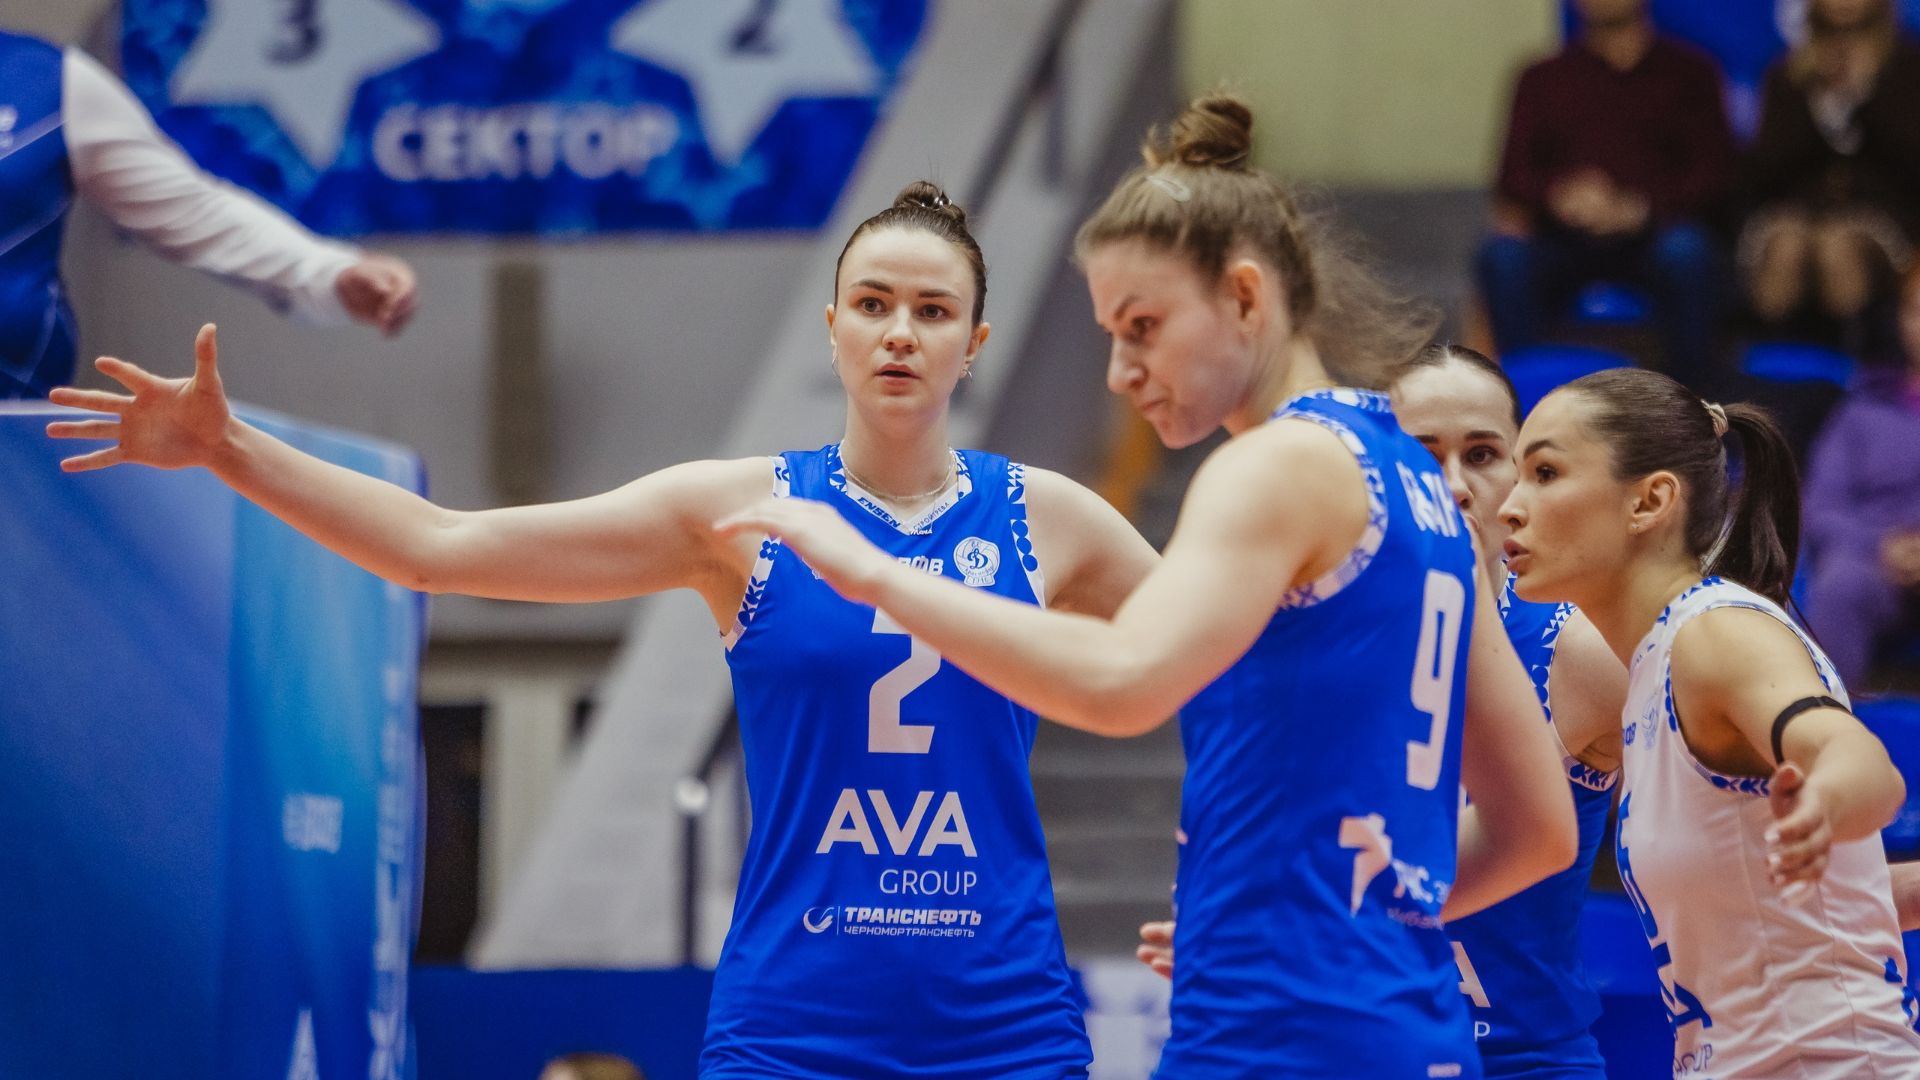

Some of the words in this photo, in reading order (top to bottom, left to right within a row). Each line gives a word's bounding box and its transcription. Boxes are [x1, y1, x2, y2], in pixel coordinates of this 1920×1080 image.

[373, 102, 681, 182] СЕКТОР
[858, 496, 901, 528] ENSEN
[868, 605, 941, 754] 2
[1406, 568, 1465, 791] 9
[815, 788, 978, 857] AVA
[879, 869, 977, 896] GROUP
[844, 906, 982, 926] ТРАНСНЕФТЬ
[844, 925, 975, 938] ЧЕРНОМОРТРАНСНЕФТЬ
